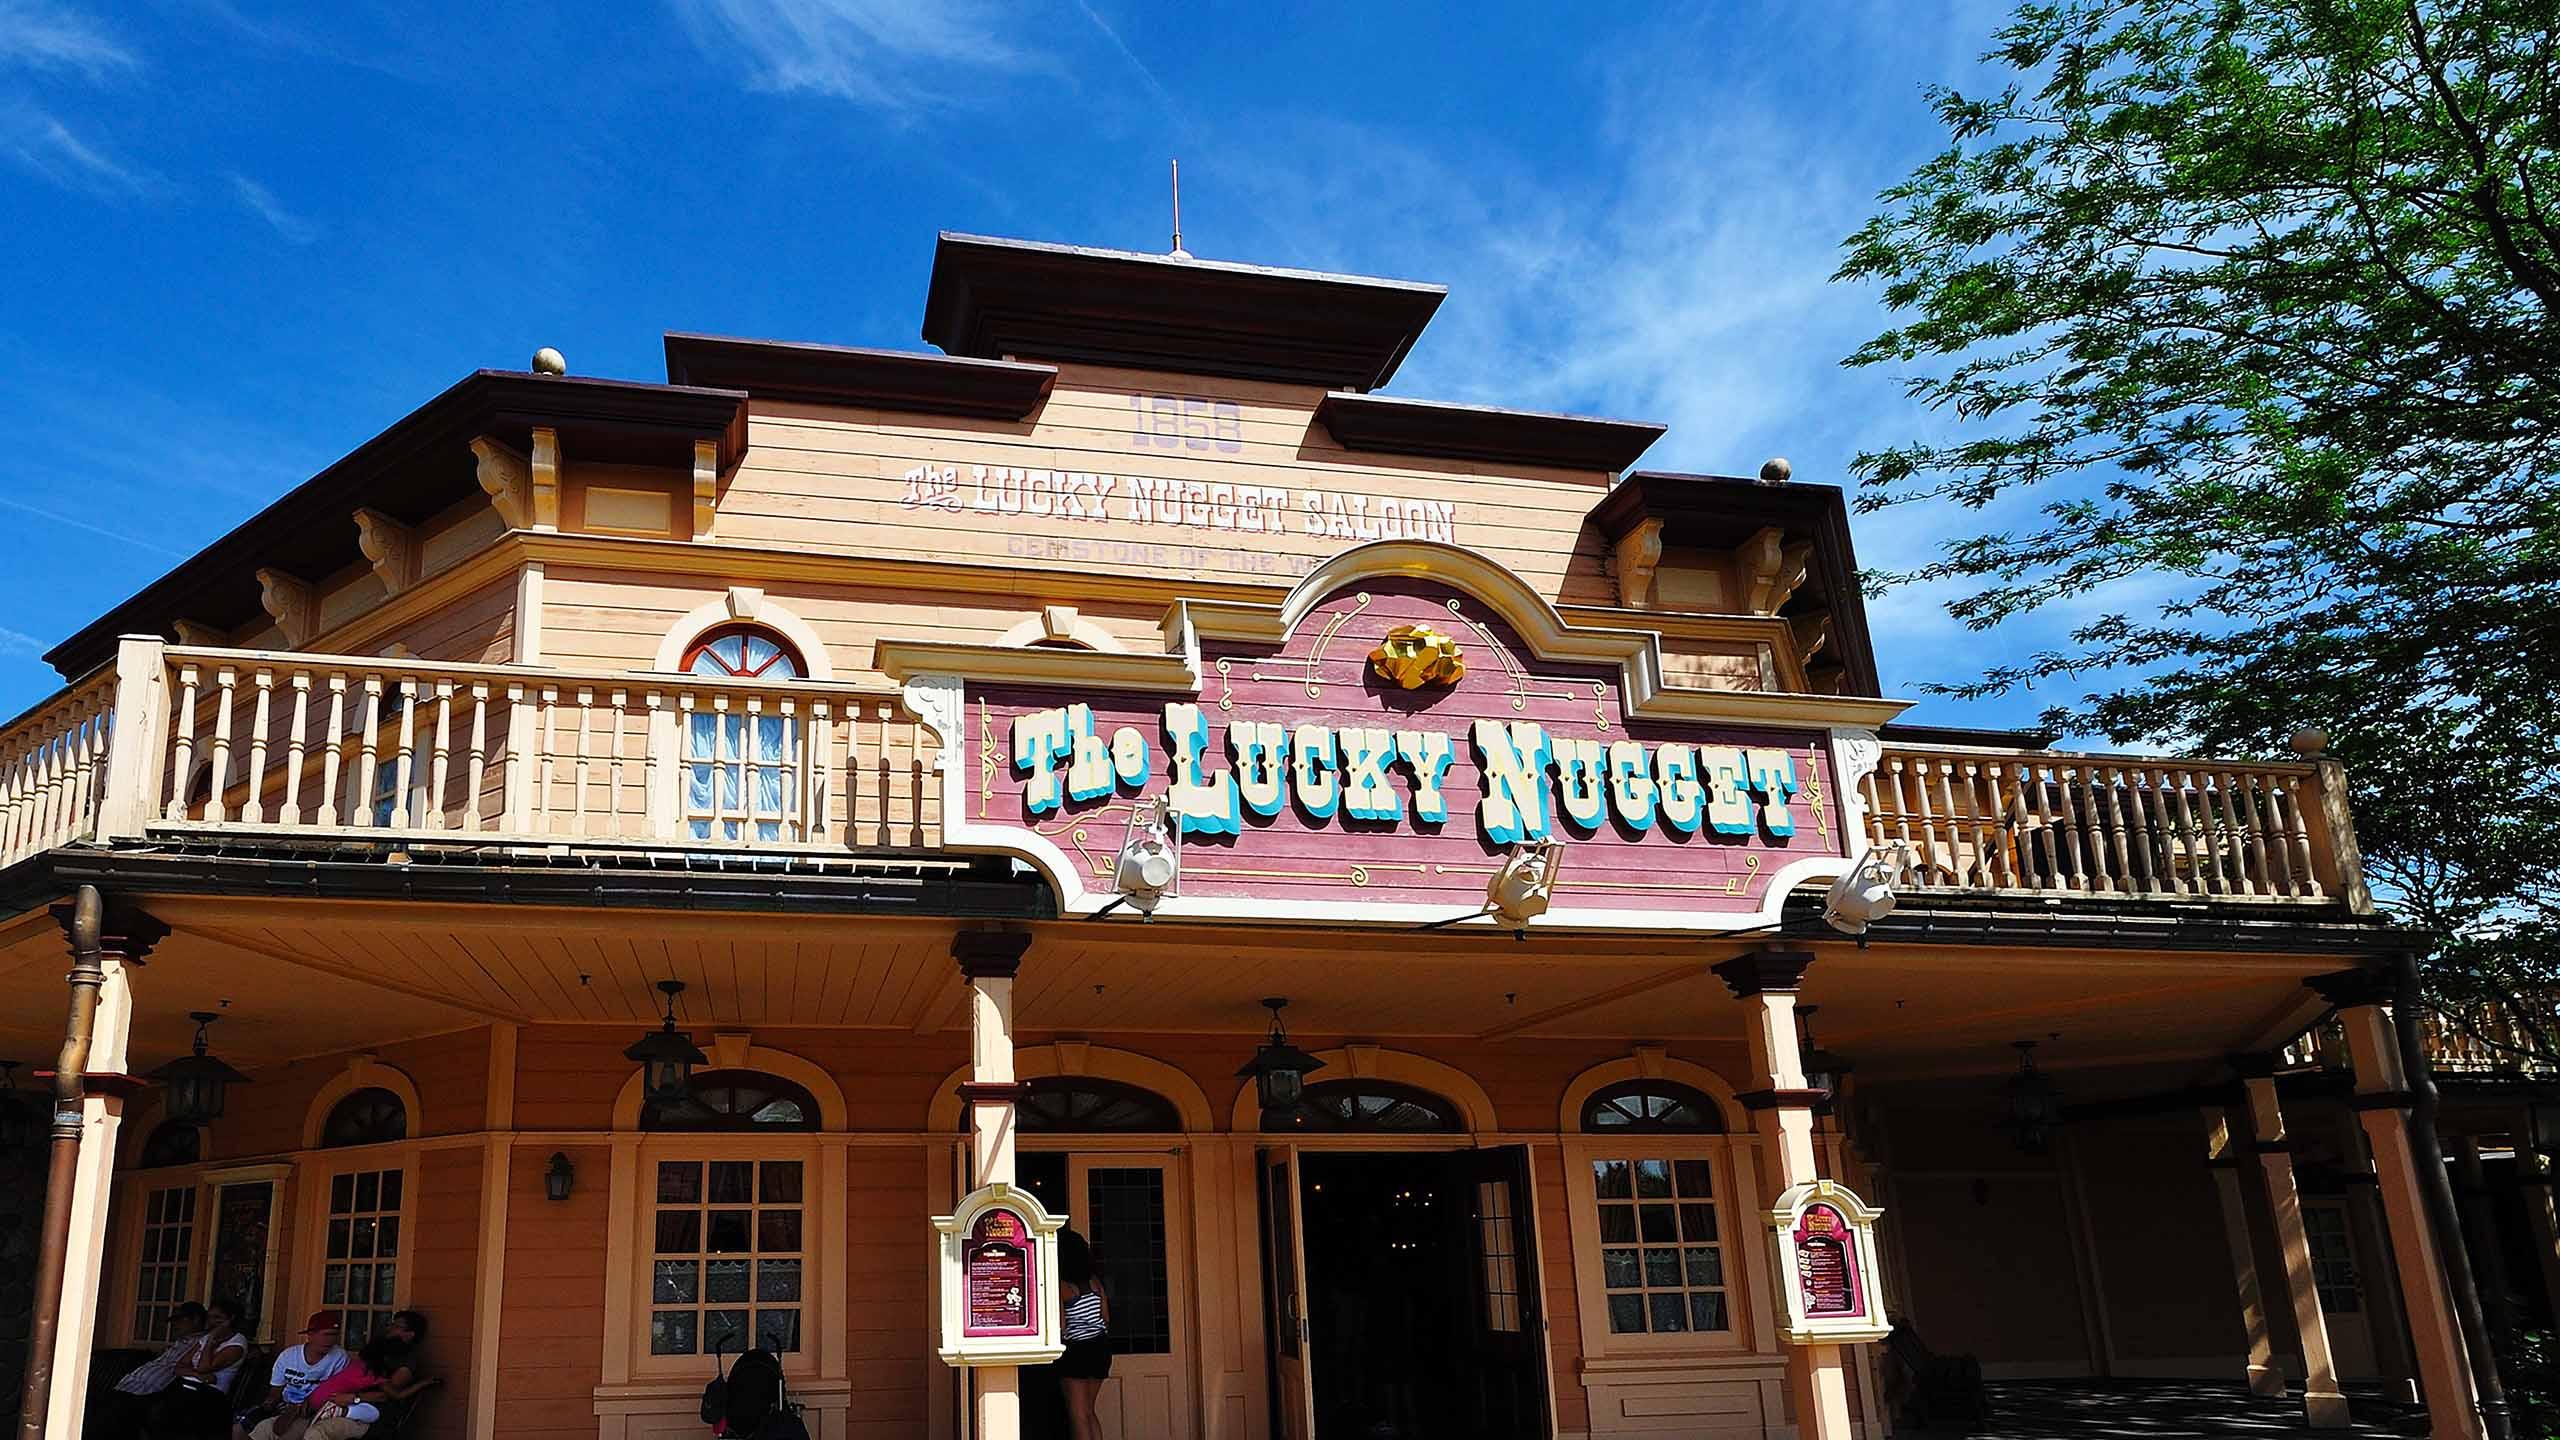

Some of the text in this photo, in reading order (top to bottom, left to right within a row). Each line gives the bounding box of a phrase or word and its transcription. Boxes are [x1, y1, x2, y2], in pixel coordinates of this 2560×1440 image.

[1129, 394, 1242, 453] 1858
[901, 463, 1457, 544] The LUCKY NUGGET SALOON
[1180, 547, 1213, 569] OF
[1014, 702, 1799, 846] The LUCKY NUGGET
